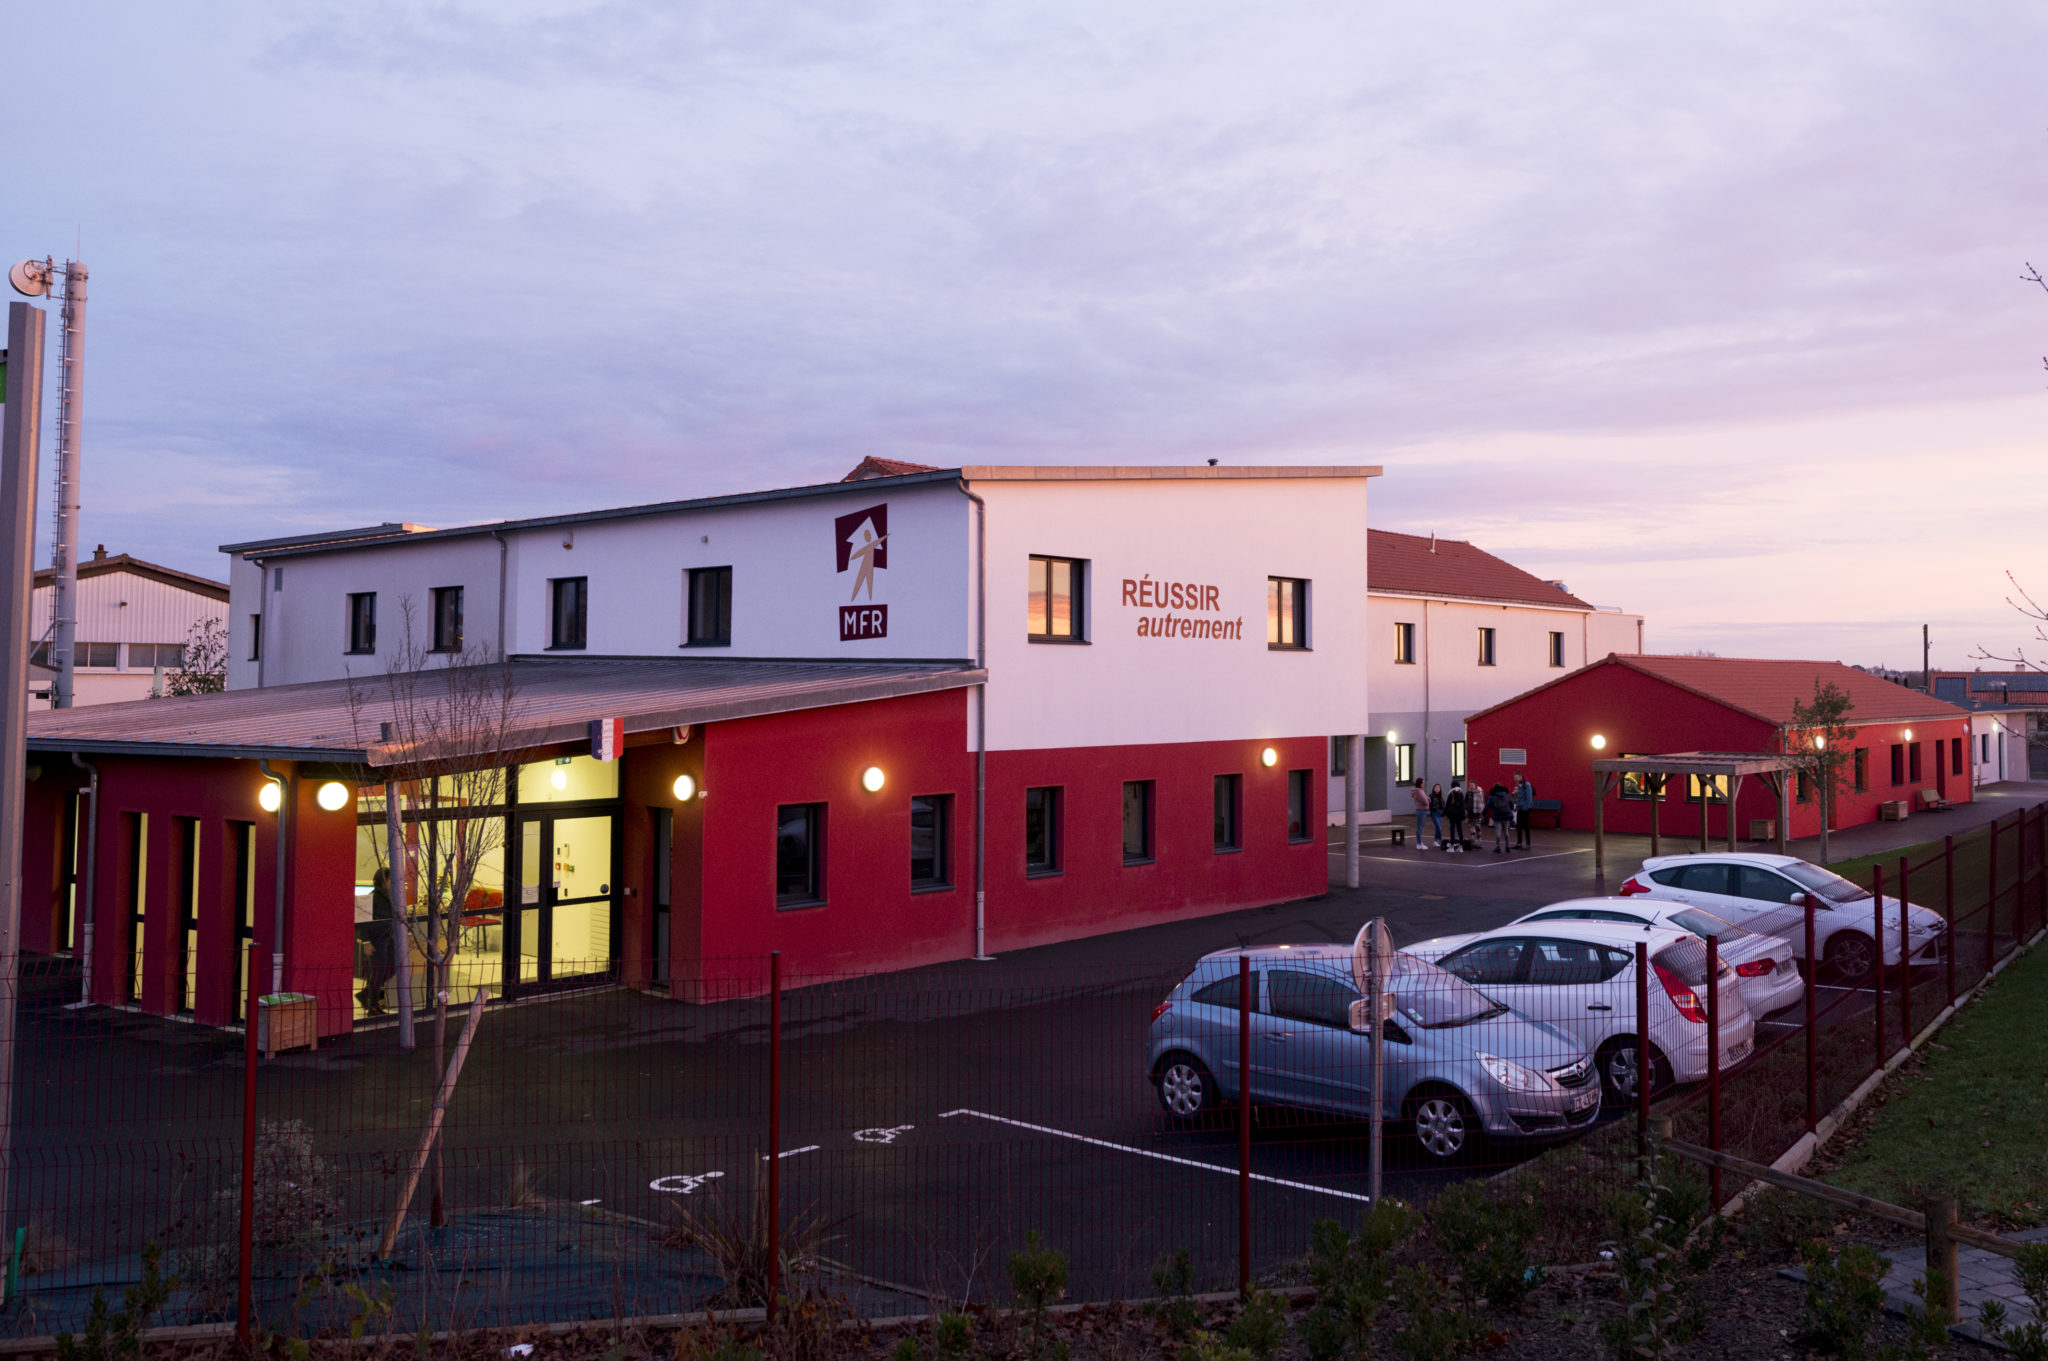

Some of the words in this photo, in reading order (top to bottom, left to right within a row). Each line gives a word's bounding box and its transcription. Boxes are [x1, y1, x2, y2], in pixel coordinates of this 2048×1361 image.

[1122, 574, 1220, 611] RÉUSSIR
[844, 610, 882, 635] MFR
[1137, 612, 1243, 640] autrement
